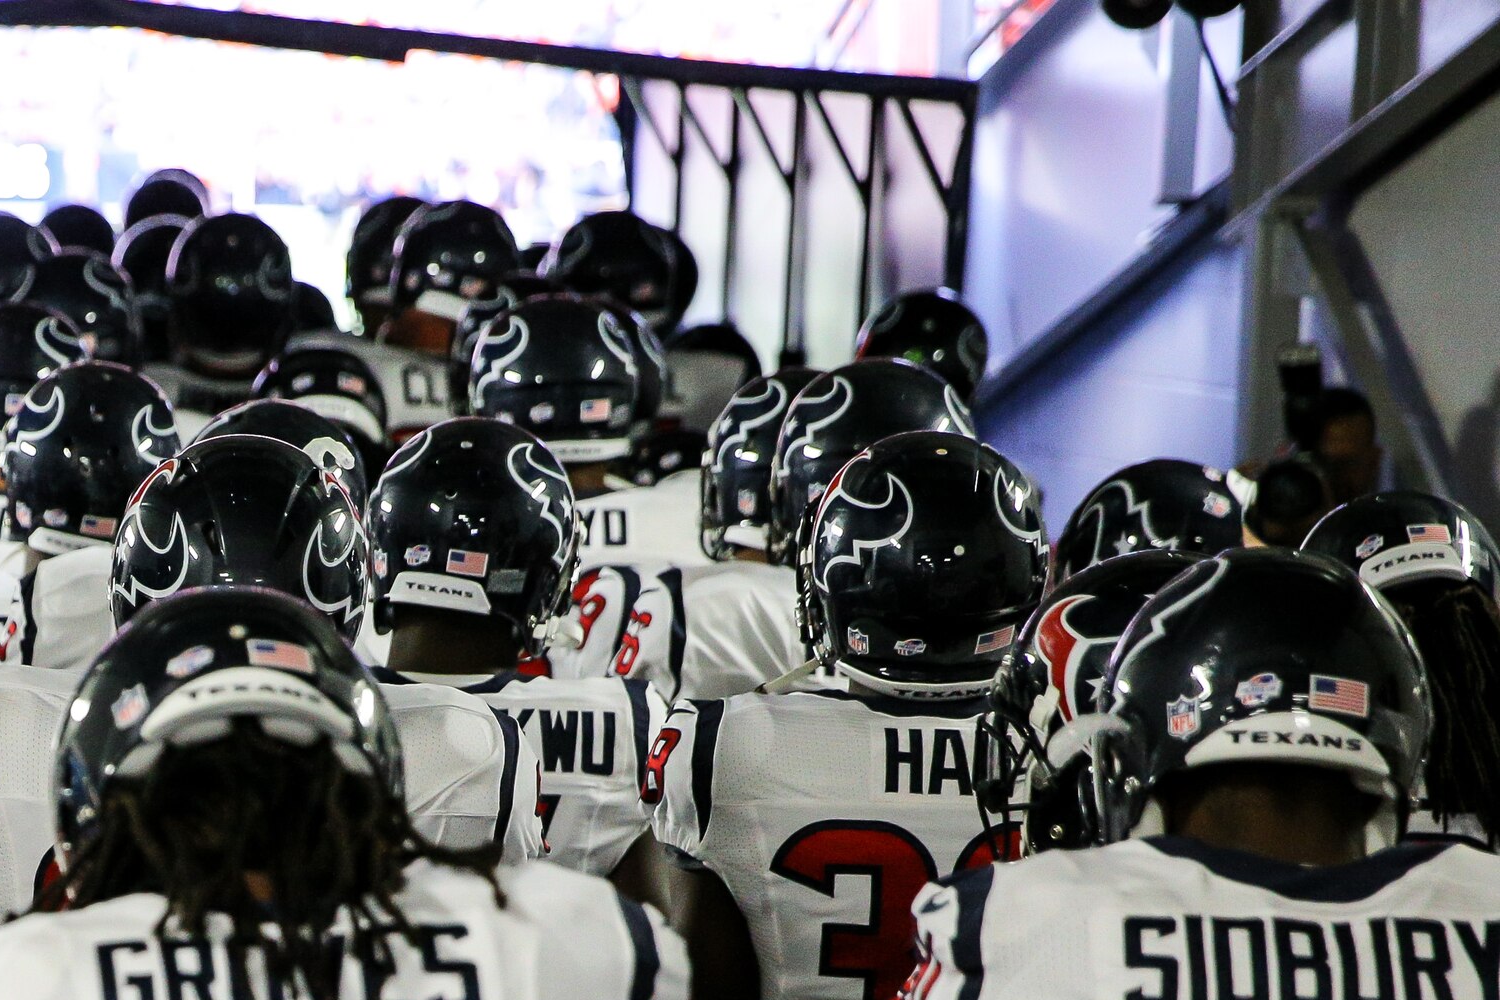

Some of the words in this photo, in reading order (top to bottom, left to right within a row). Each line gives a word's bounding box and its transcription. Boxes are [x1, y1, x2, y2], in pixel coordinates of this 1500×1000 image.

[1370, 551, 1445, 574] TEXANS
[404, 581, 473, 599] TEXANS
[1170, 715, 1196, 733] NFL
[1223, 729, 1362, 751] TEXANS
